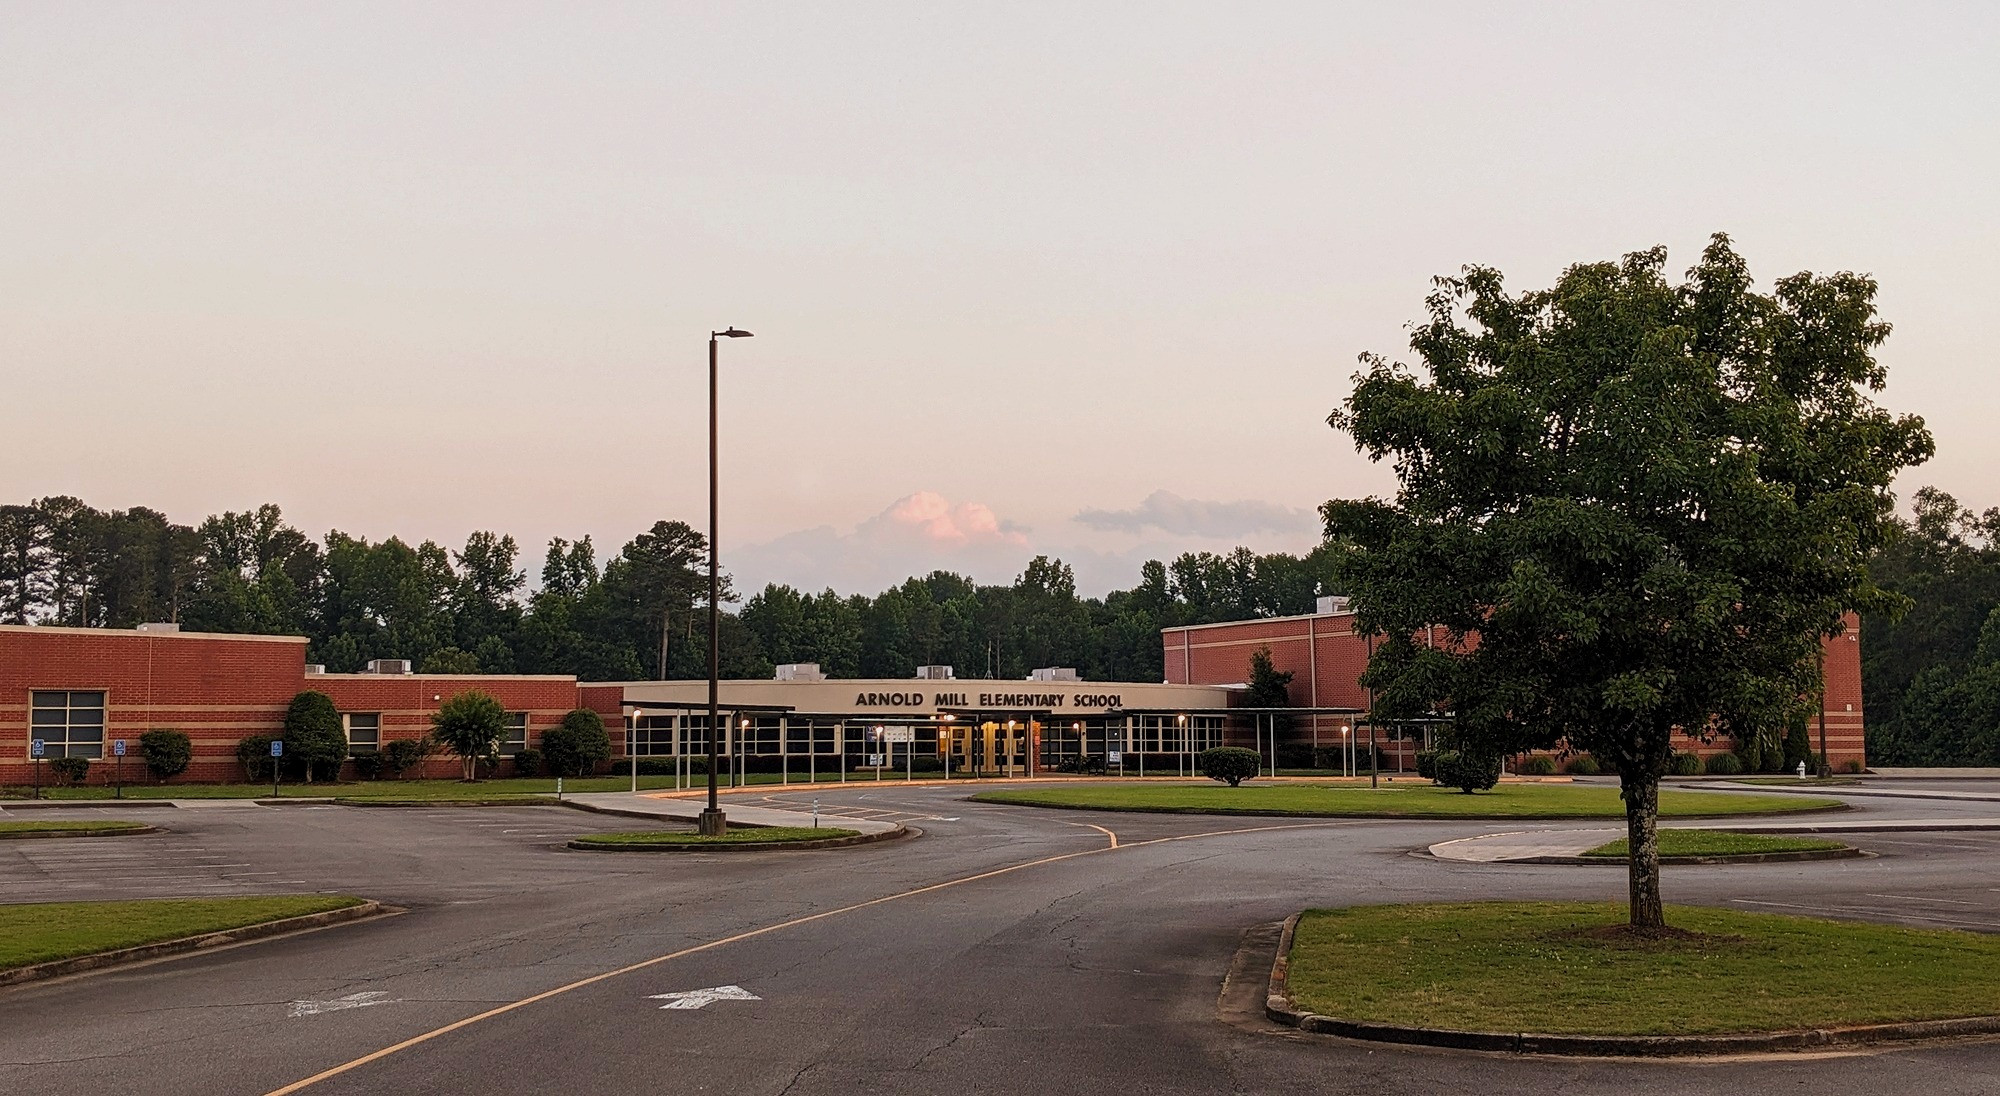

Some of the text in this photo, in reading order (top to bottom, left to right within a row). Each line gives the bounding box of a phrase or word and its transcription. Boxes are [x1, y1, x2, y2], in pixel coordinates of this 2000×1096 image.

[855, 692, 1123, 708] ARNOLD MILL ELEMENTARY SCHOOL
